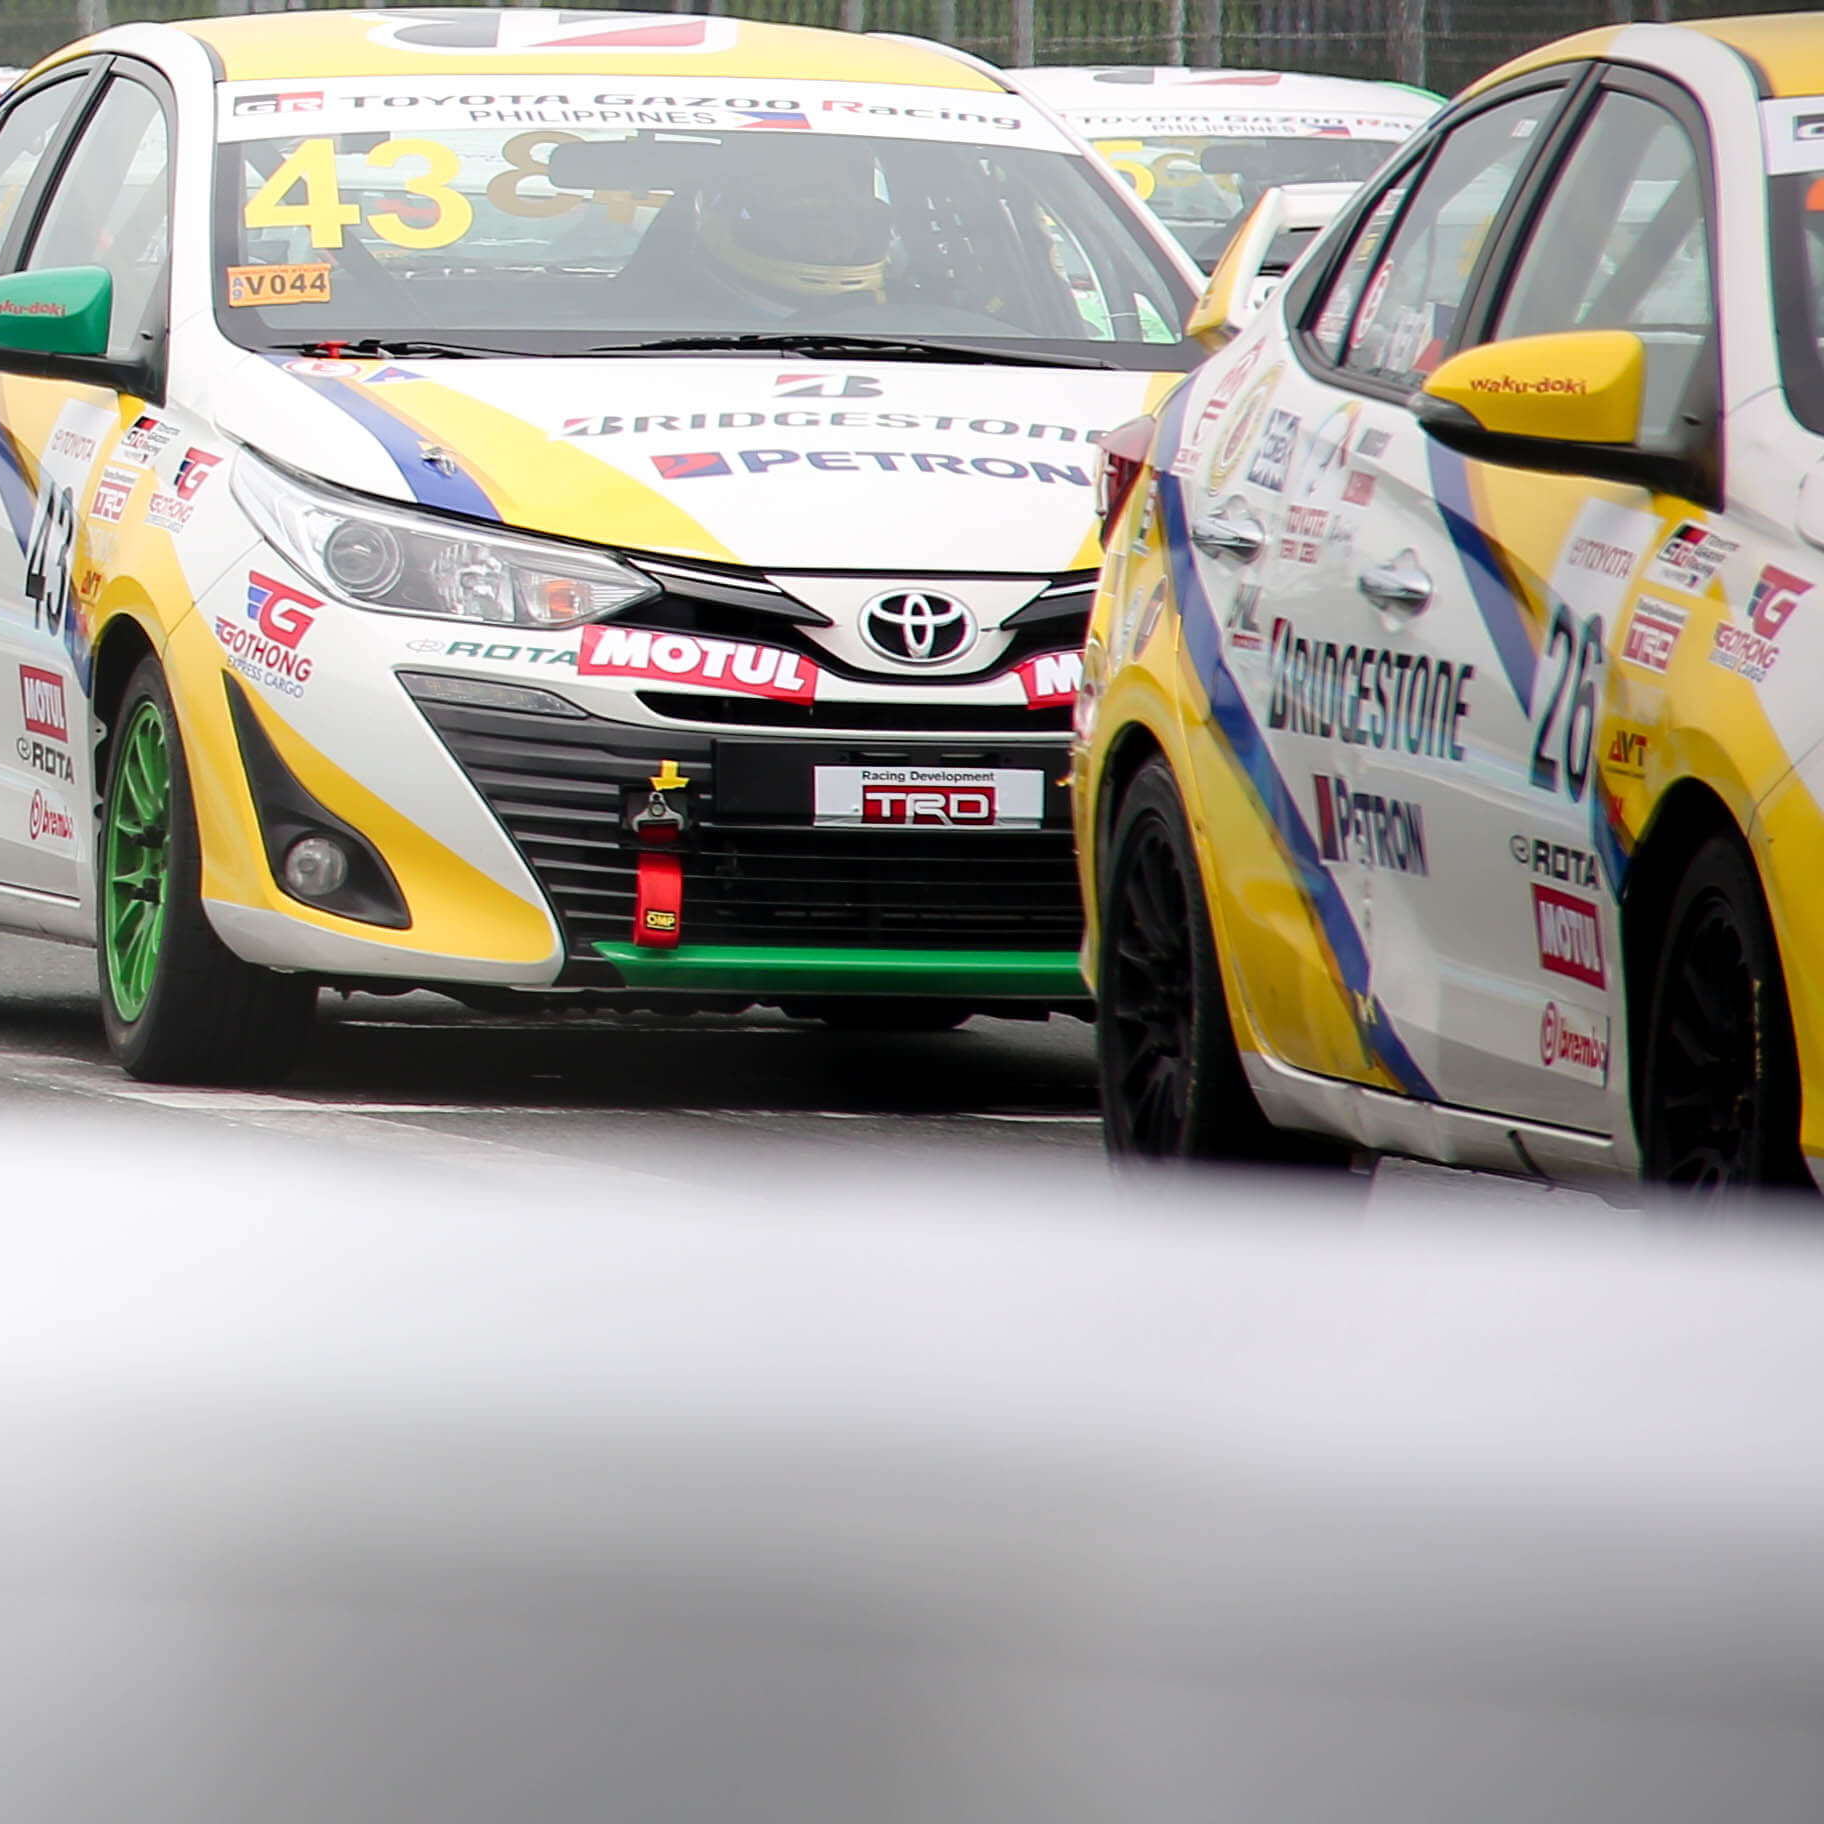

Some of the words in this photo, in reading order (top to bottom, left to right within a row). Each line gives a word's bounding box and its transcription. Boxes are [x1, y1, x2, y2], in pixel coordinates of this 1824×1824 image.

[339, 93, 568, 109] TOYOTA
[594, 93, 800, 110] GAZOO
[823, 99, 1022, 131] Racing
[470, 110, 717, 126] PHILIPPINES
[243, 138, 473, 249] 43
[245, 272, 327, 296] V044
[1469, 376, 1588, 396] waku-doki
[740, 449, 1093, 487] PETRON
[25, 480, 74, 637] 43
[215, 615, 313, 682] GOTHONG
[444, 639, 581, 667] ROTA
[590, 629, 808, 693] MOTUL
[1713, 620, 1781, 670] GOTHONG
[23, 675, 66, 731] MOTUL
[264, 671, 304, 699] CARGO
[1268, 617, 1475, 763] BRIDGESTONE
[1530, 603, 1606, 803] 26
[31, 741, 76, 785] ROTA
[862, 770, 907, 784] Racing
[910, 770, 995, 784] Development
[864, 792, 990, 825] TRD
[1334, 775, 1430, 876] PETRON
[1531, 838, 1602, 892] ROTA
[646, 912, 676, 928] OMP
[1537, 900, 1603, 974] MOTUL
[1558, 1015, 1607, 1070] brembo
